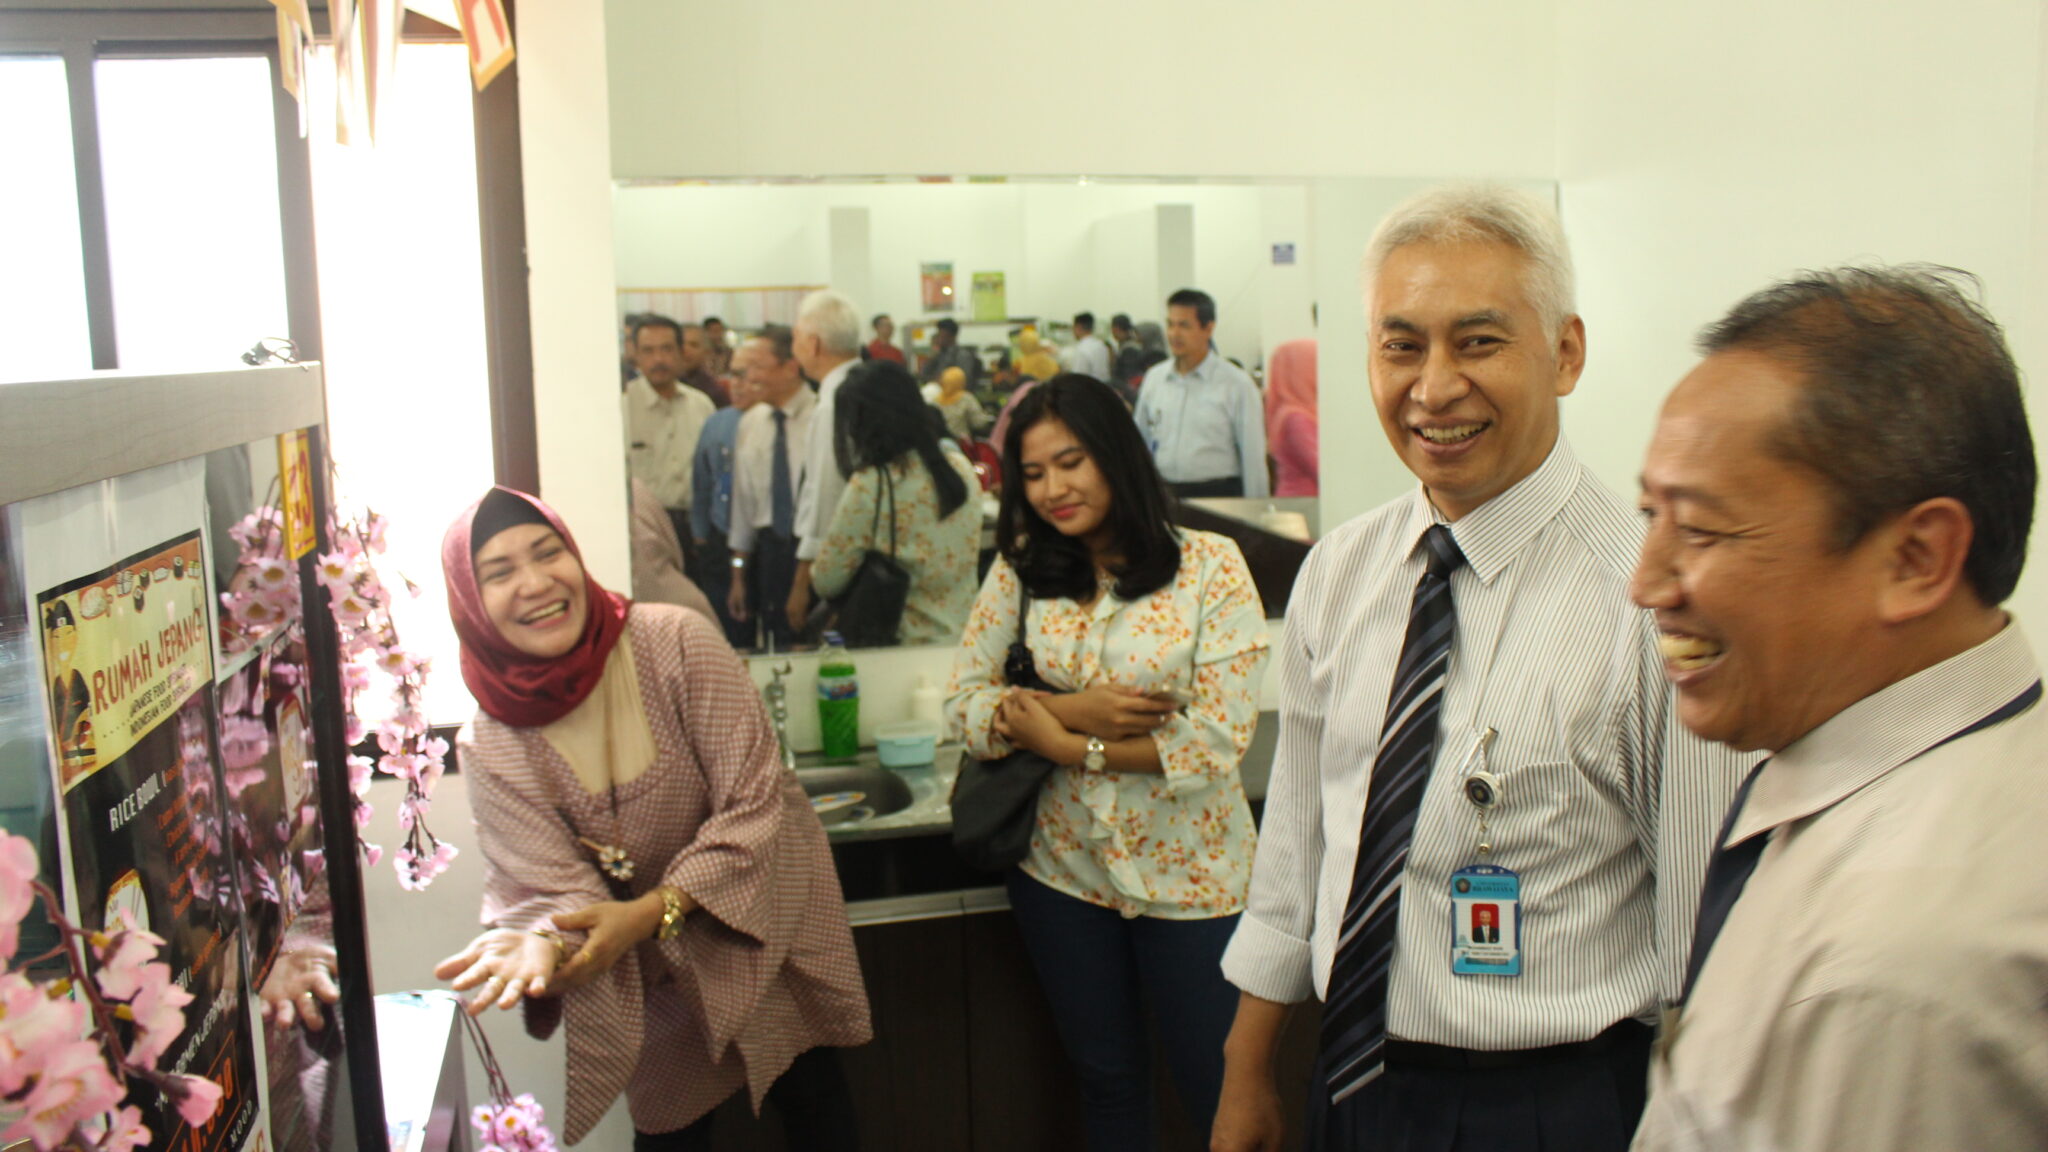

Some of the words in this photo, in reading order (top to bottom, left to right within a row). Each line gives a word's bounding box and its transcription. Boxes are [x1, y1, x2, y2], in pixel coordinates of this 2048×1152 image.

[93, 640, 152, 714] RUMAH
[157, 607, 203, 668] JEPANG
[109, 793, 136, 832] RICE
